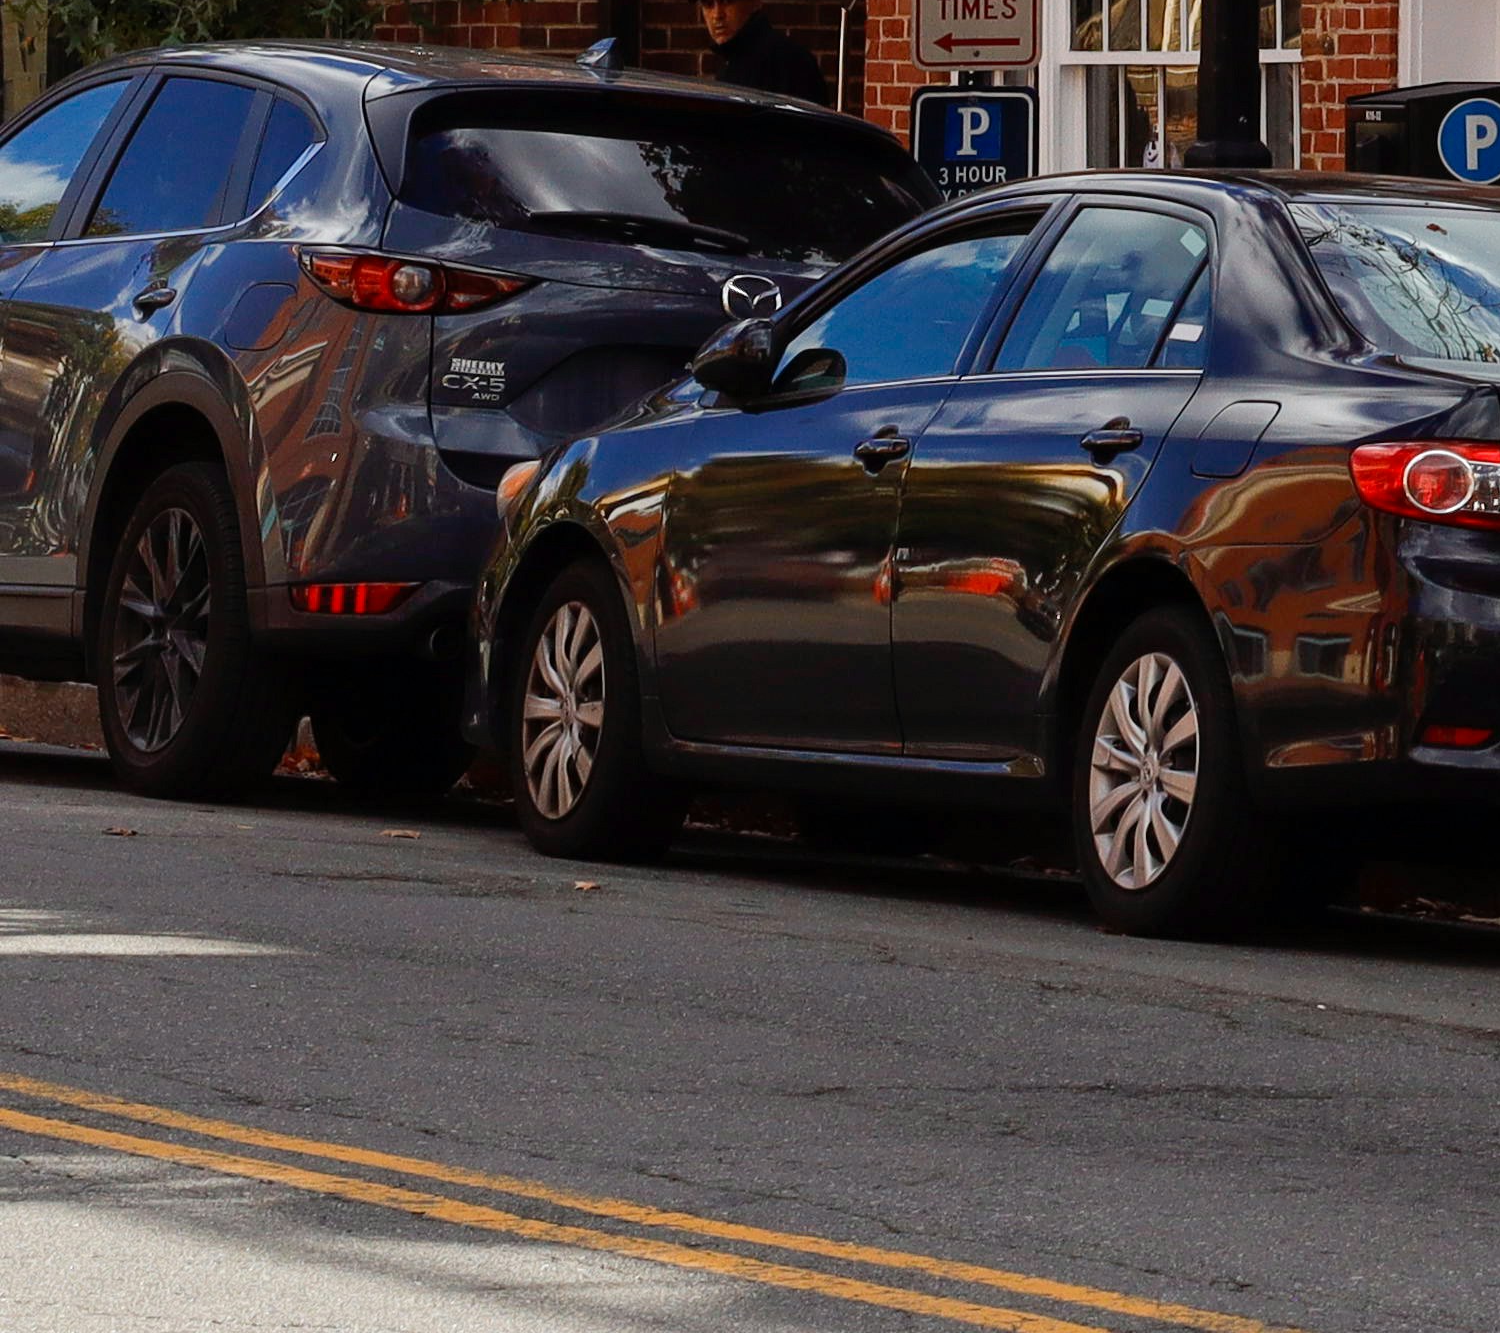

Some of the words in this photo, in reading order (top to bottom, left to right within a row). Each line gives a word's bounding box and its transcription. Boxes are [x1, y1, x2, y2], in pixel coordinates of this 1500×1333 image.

[956, 106, 990, 156] P
[1465, 114, 1498, 171] P
[938, 167, 949, 185] 3
[955, 165, 1007, 183] HOUR
[442, 374, 506, 392] CX-5
[472, 393, 500, 402] AWD
